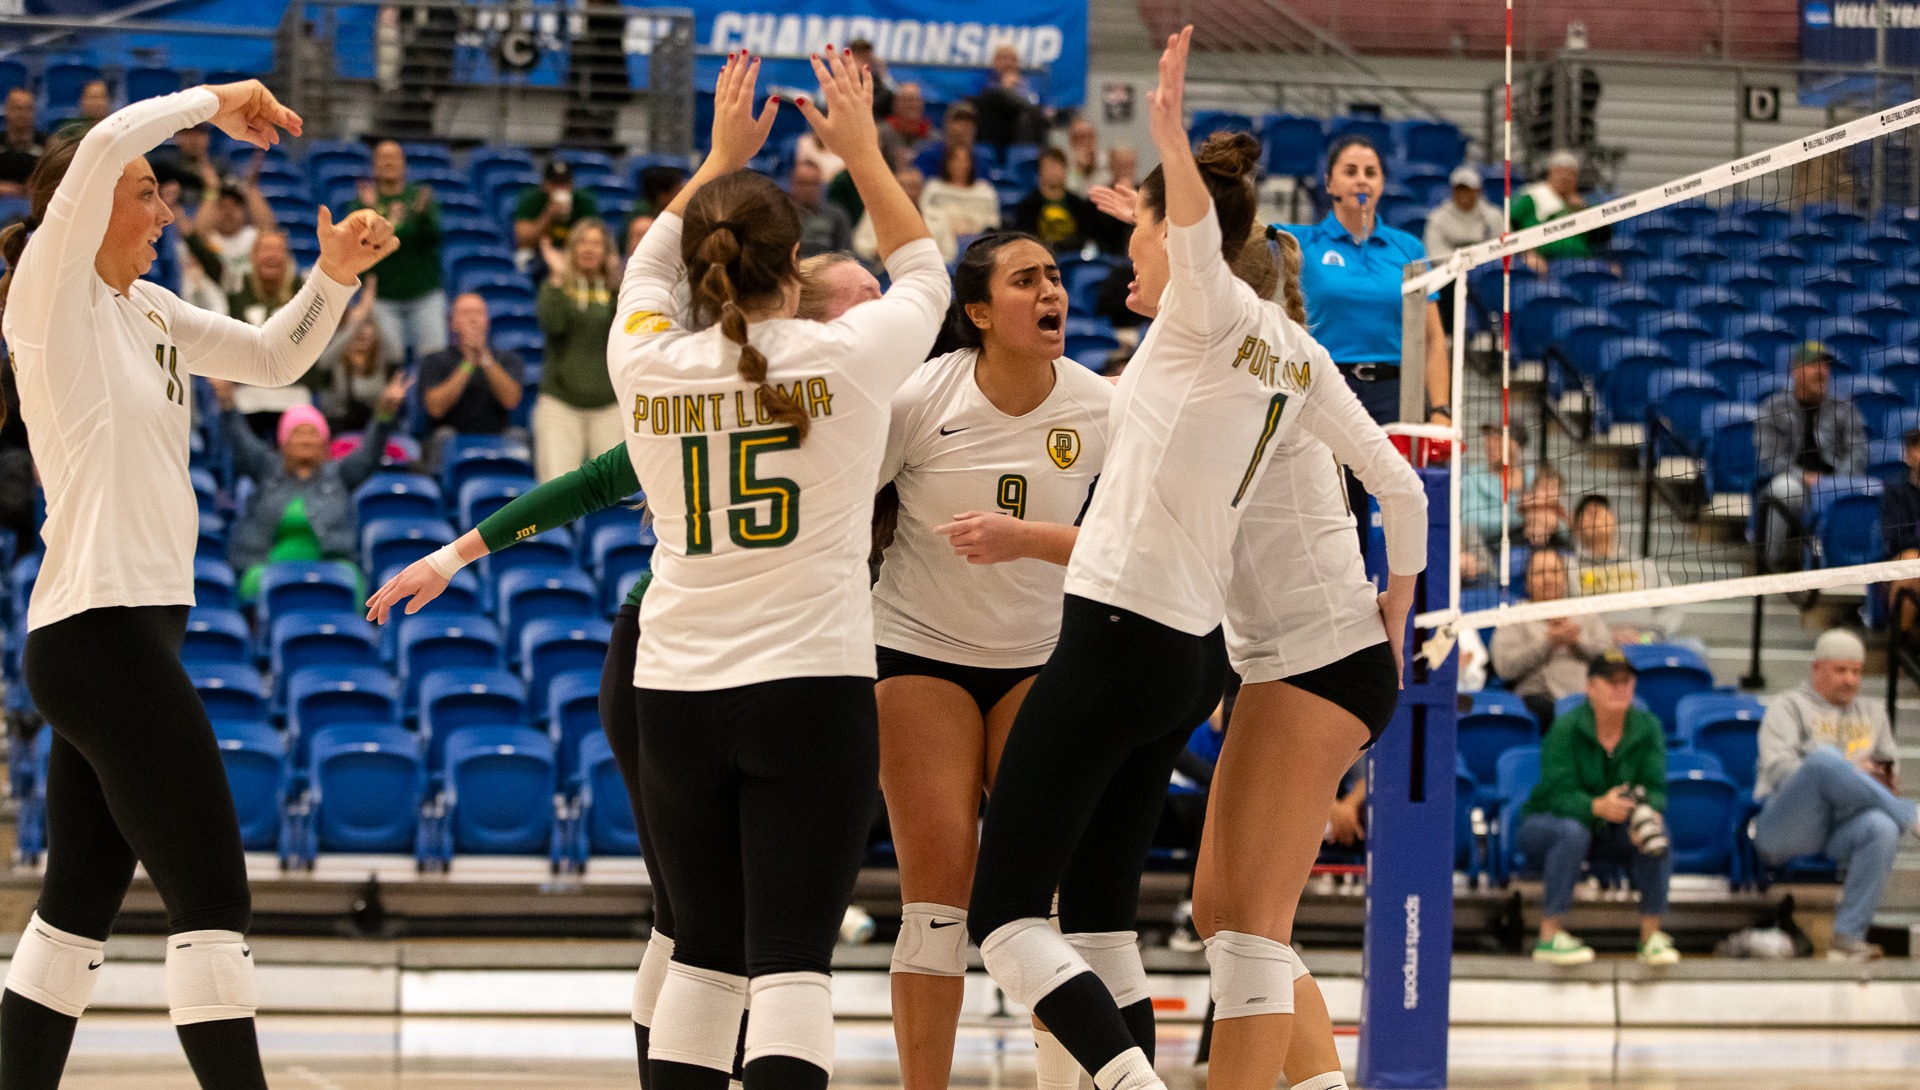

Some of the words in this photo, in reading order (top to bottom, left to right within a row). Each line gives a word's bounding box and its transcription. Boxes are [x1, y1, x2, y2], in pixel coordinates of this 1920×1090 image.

[503, 32, 535, 67] C
[711, 11, 1063, 67] CHAMPIONSHIP
[1751, 90, 1776, 119] D
[633, 393, 725, 435] POINT
[680, 426, 801, 556] 15
[996, 474, 1028, 521] 9
[515, 524, 537, 540] JOY
[1404, 894, 1421, 946] sports
